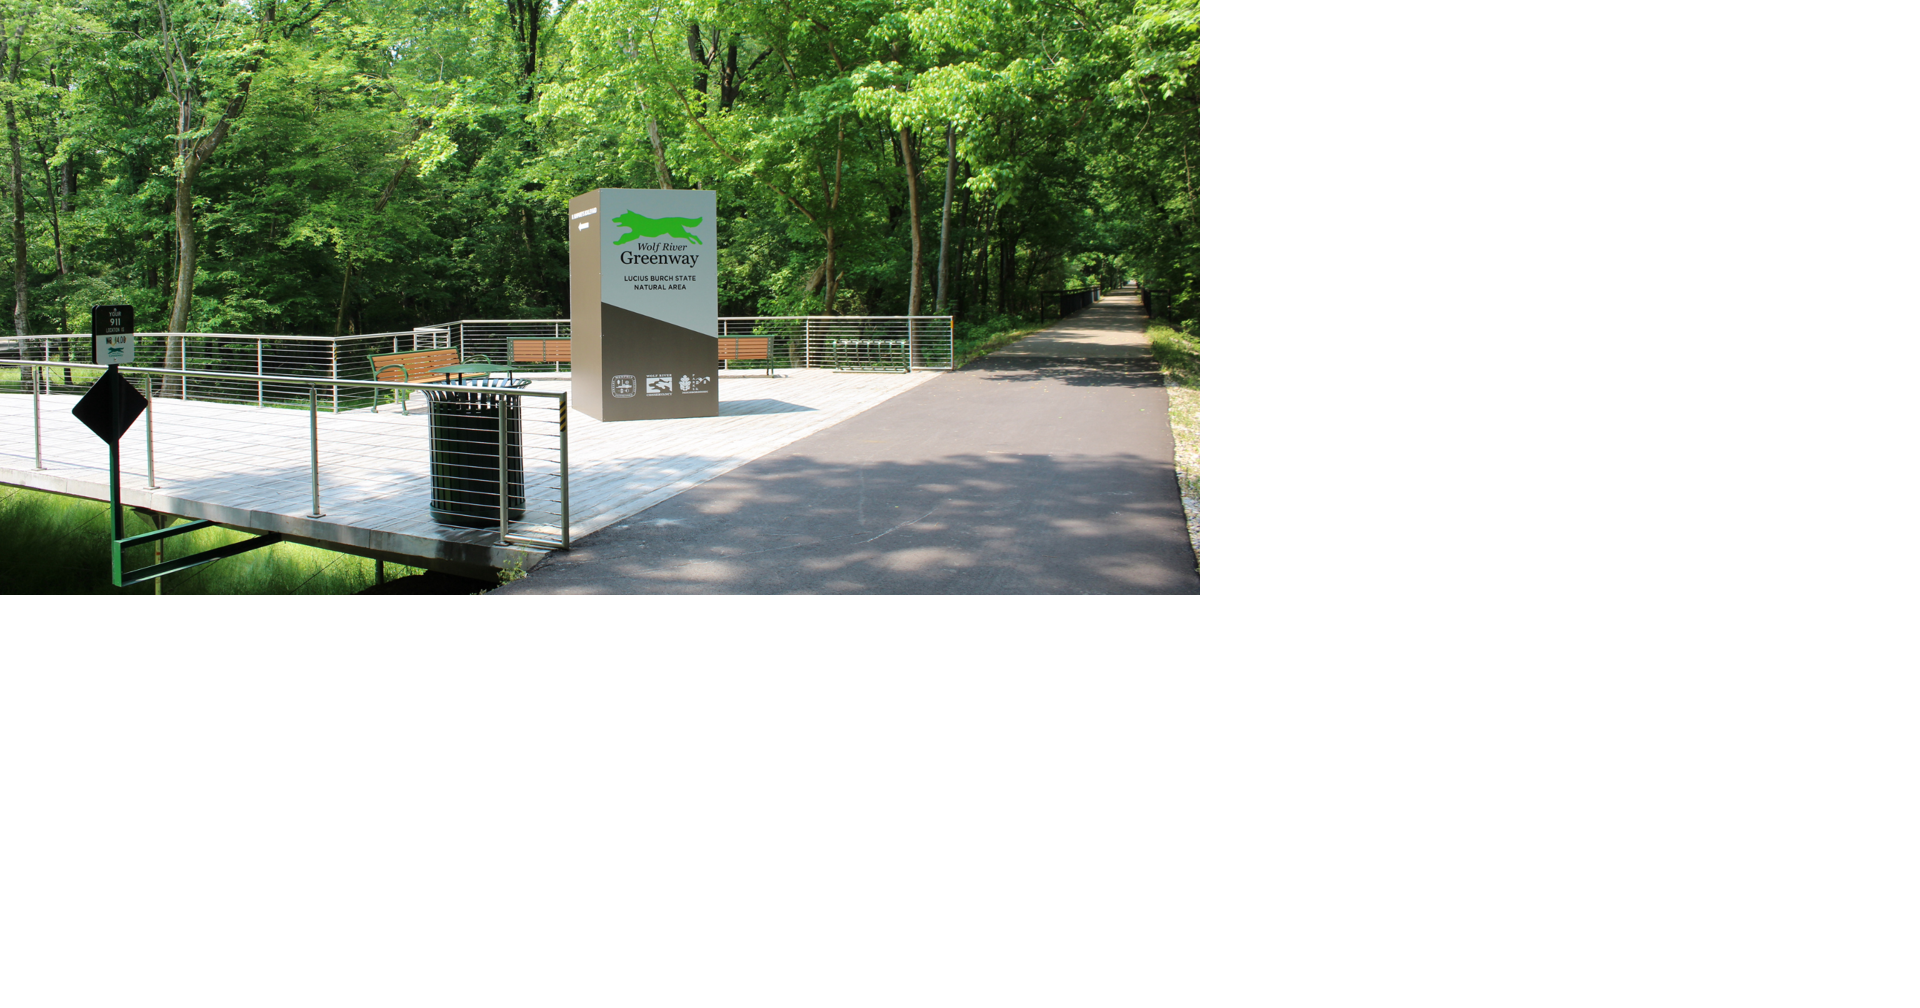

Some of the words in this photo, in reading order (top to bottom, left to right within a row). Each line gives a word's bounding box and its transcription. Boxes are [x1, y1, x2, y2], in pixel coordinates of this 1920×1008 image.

[638, 242, 661, 253] Wolf
[662, 242, 687, 251] River
[620, 251, 699, 268] Greenway
[109, 318, 121, 326] 911
